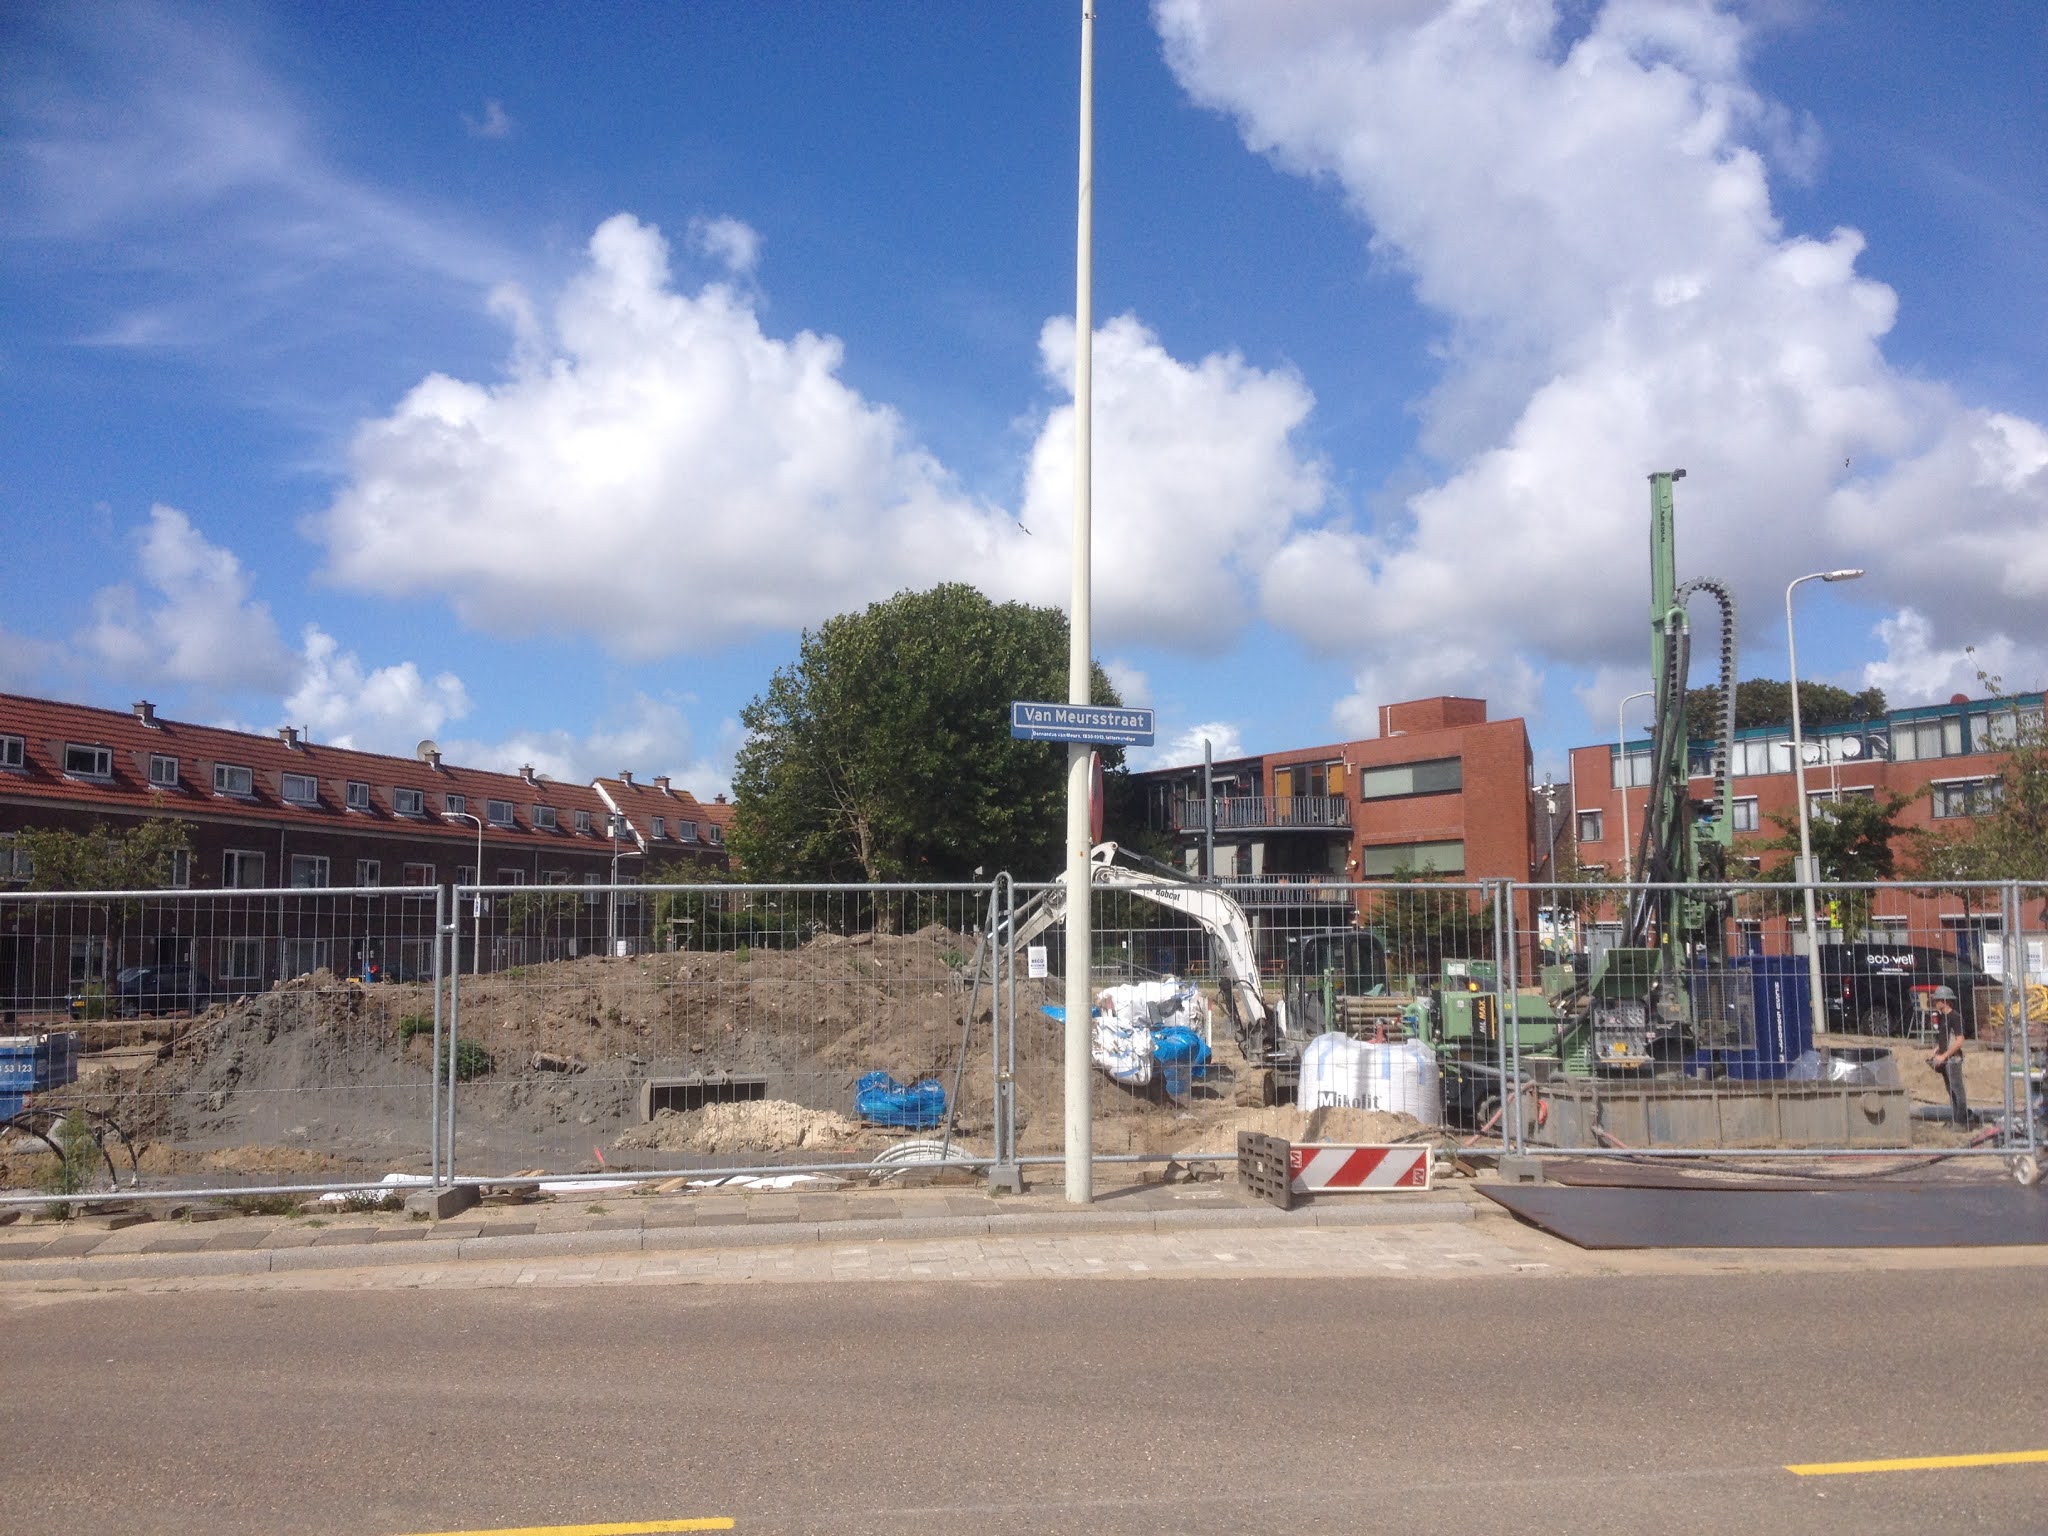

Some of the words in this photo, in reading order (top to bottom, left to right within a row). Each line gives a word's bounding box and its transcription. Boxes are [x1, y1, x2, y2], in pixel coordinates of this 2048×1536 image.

[1024, 707, 1051, 722] Van
[1055, 709, 1144, 727] Meursstraat
[1156, 889, 1181, 901] Bobcat
[1478, 999, 1486, 1020] MAX
[4, 1064, 15, 1073] 53
[18, 1064, 33, 1073] 123
[1317, 1090, 1380, 1110] Mikolit
